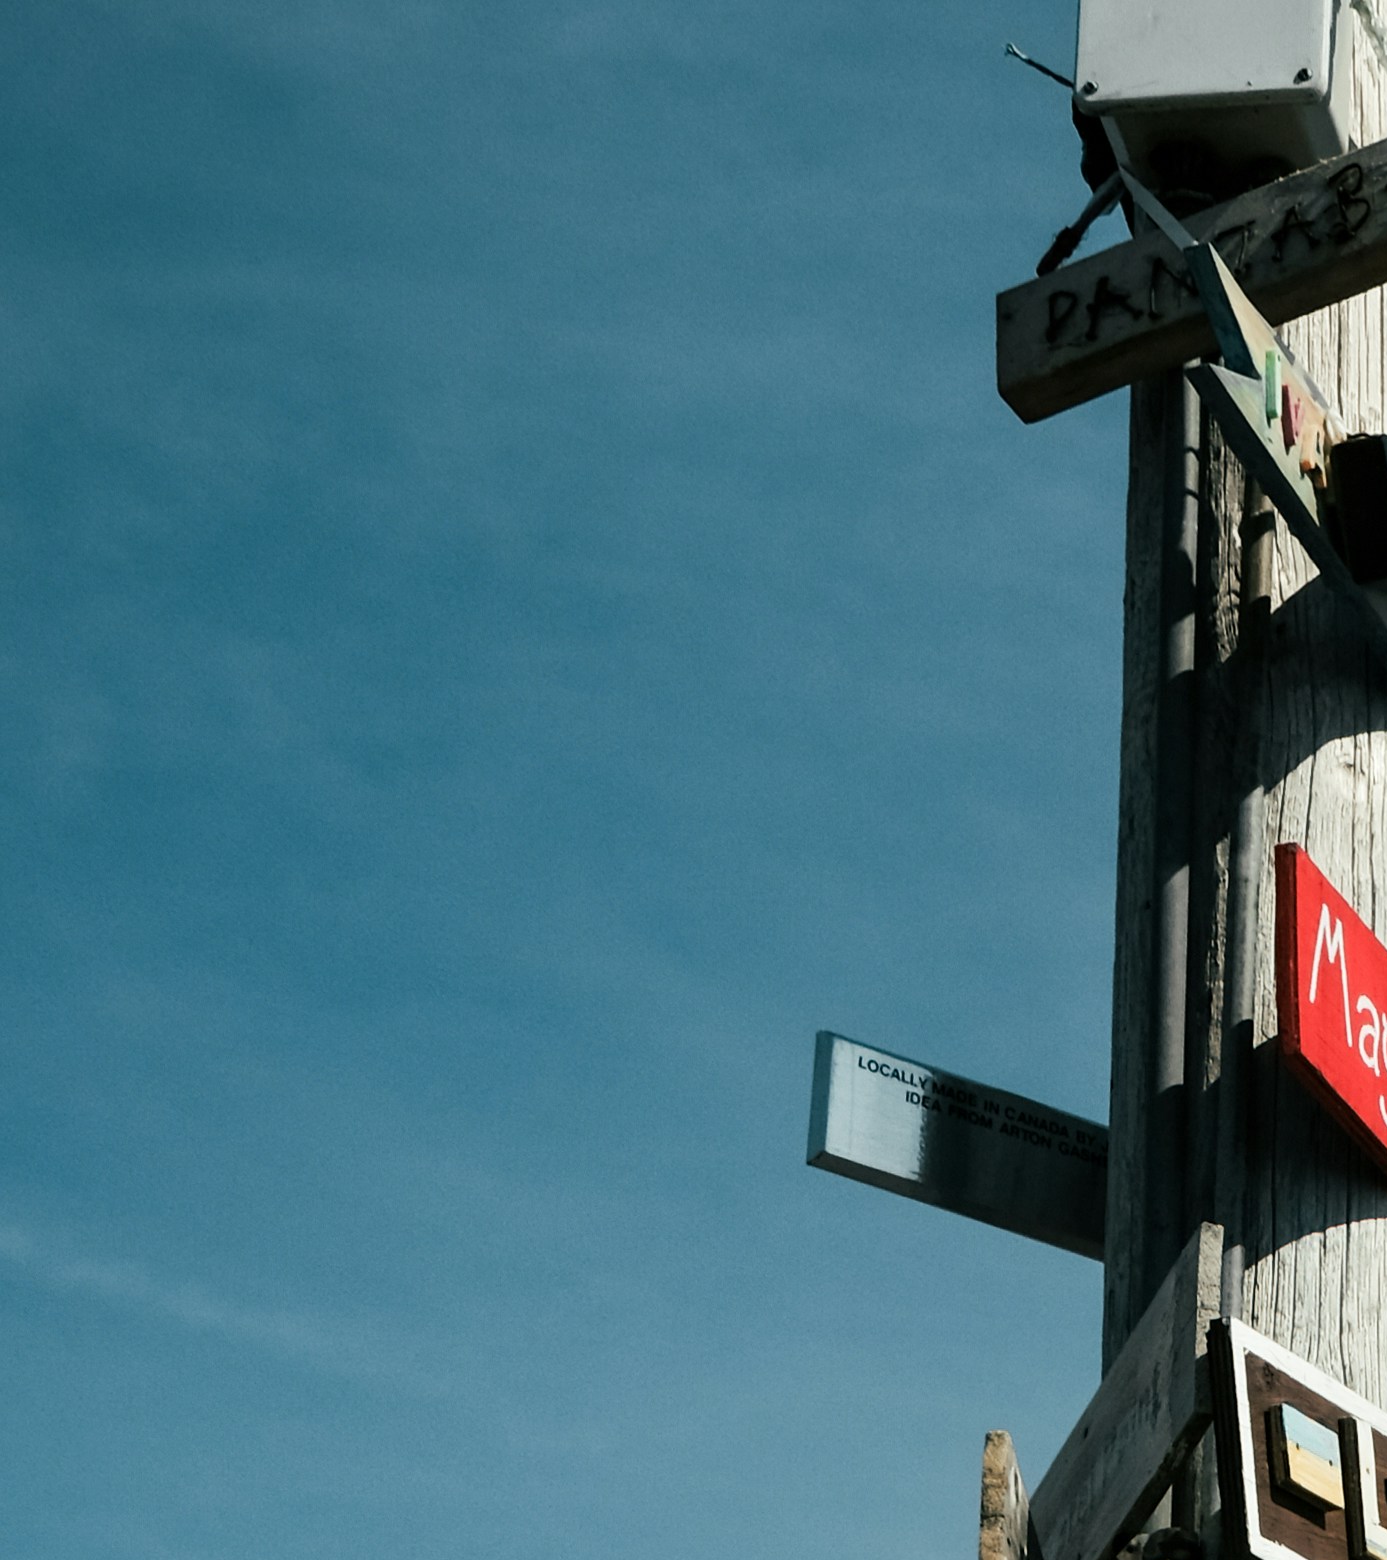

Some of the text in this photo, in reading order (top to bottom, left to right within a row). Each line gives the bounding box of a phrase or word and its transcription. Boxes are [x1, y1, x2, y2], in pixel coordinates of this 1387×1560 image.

[857, 1055, 928, 1090] LOCALLY
[932, 1081, 978, 1108] MADE
[983, 1096, 1000, 1115] IN
[1004, 1106, 1069, 1139] CANADA
[1076, 1130, 1096, 1148] BY
[905, 1090, 942, 1113] IDEA
[948, 1103, 993, 1129] FROM
